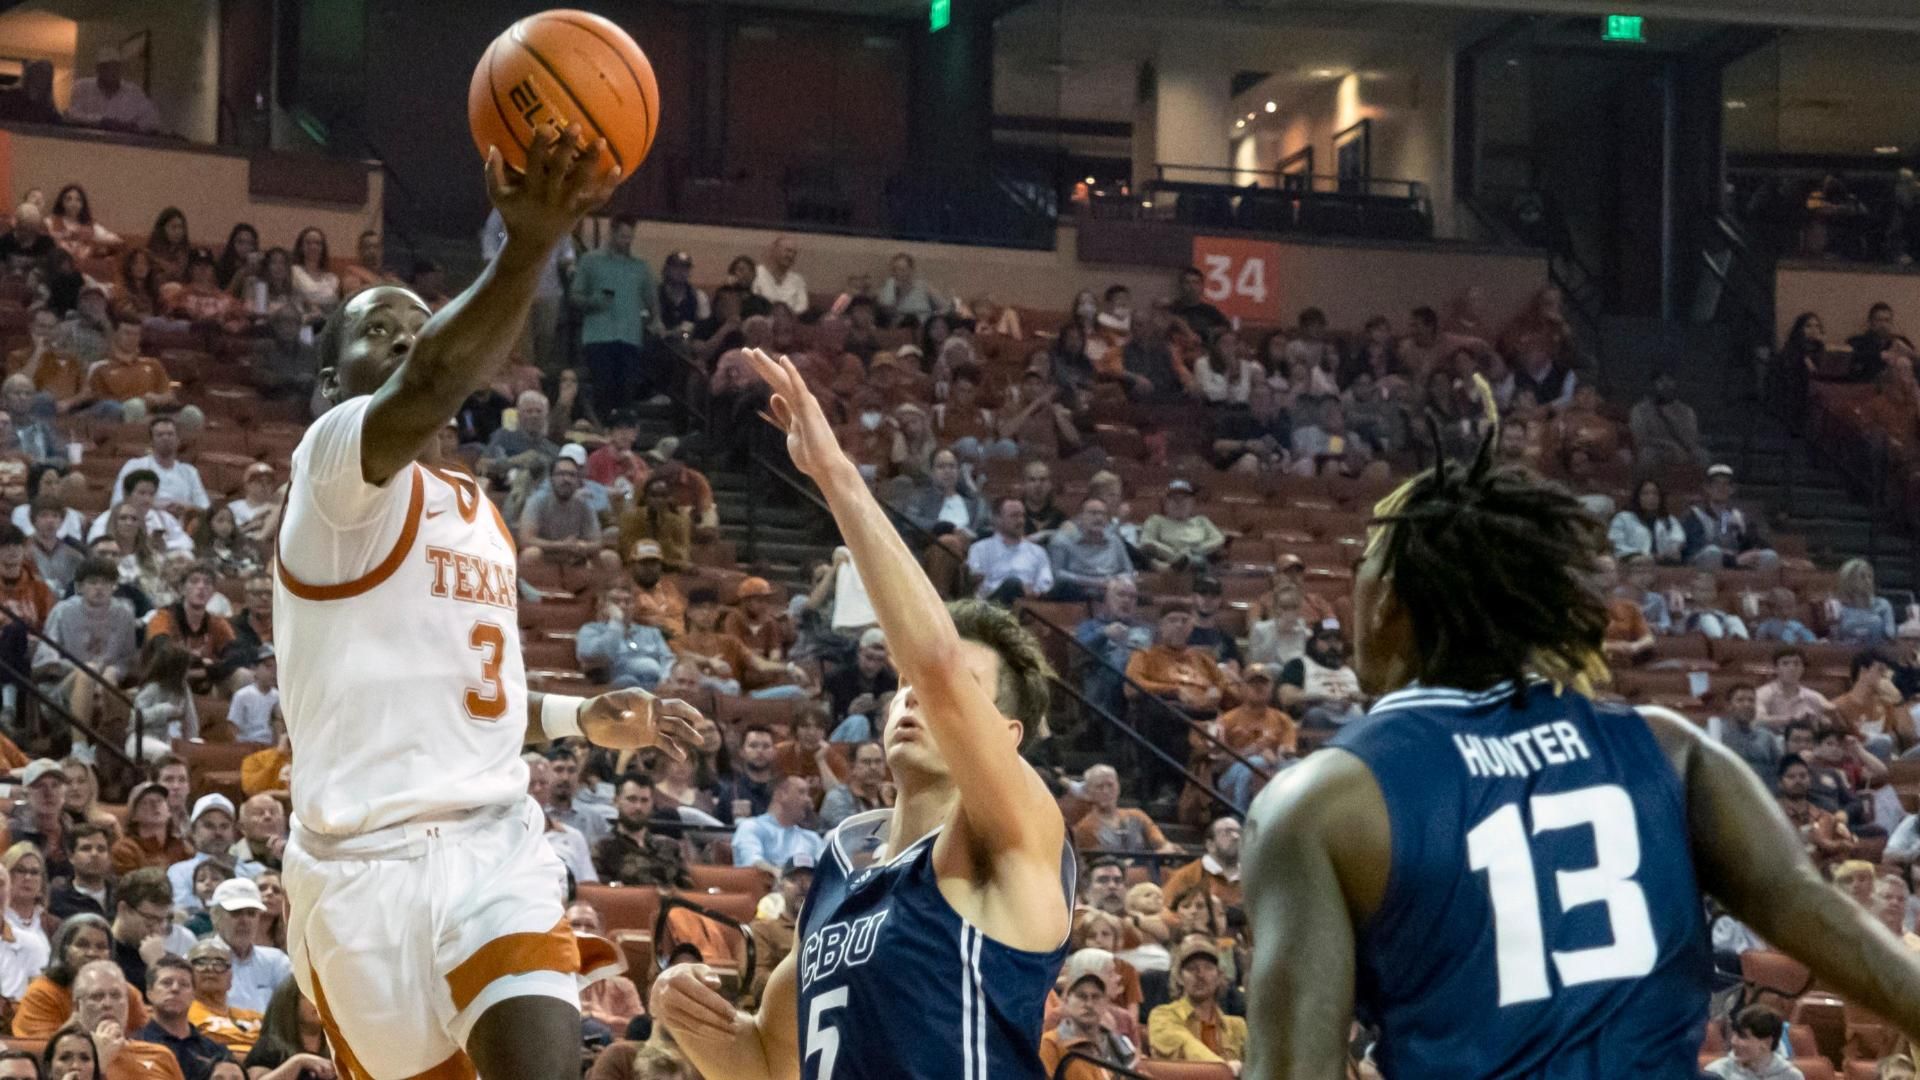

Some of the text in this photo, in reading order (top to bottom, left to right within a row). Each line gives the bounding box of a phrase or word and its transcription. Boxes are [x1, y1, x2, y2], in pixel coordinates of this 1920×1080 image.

[1203, 254, 1267, 302] 34
[463, 620, 508, 723] 3
[1453, 720, 1591, 778] HUNTER
[1467, 784, 1658, 1007] 13
[801, 909, 889, 993] CBU
[805, 986, 849, 1080] 5
